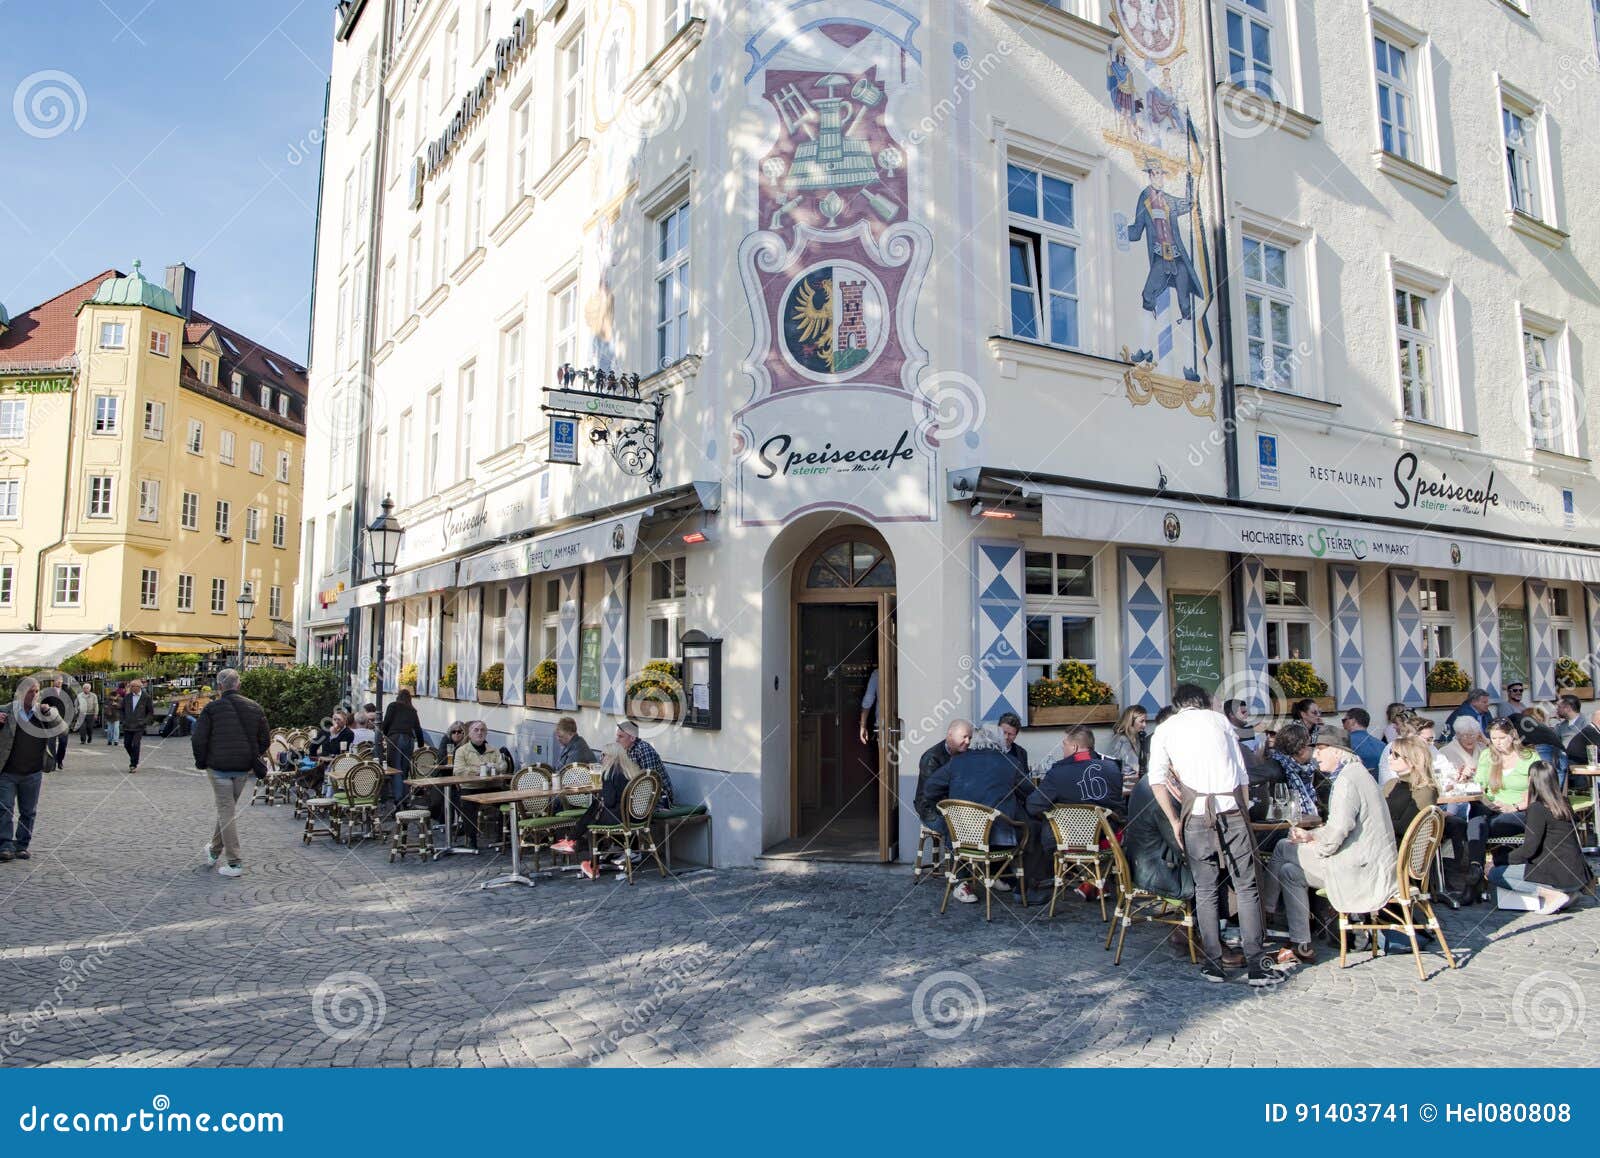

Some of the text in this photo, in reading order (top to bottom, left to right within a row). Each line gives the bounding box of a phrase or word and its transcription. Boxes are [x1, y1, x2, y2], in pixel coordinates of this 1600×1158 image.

[15, 379, 72, 393] SCHMITZ
[757, 429, 914, 479] Speisecafe
[791, 466, 831, 476] steirer
[1309, 466, 1383, 489] RESTAURANT
[1394, 452, 1500, 517] Speisecafe
[1241, 530, 1304, 547] HOCHREITER'S
[1372, 542, 1383, 552] AM
[1385, 543, 1410, 556] MARKT
